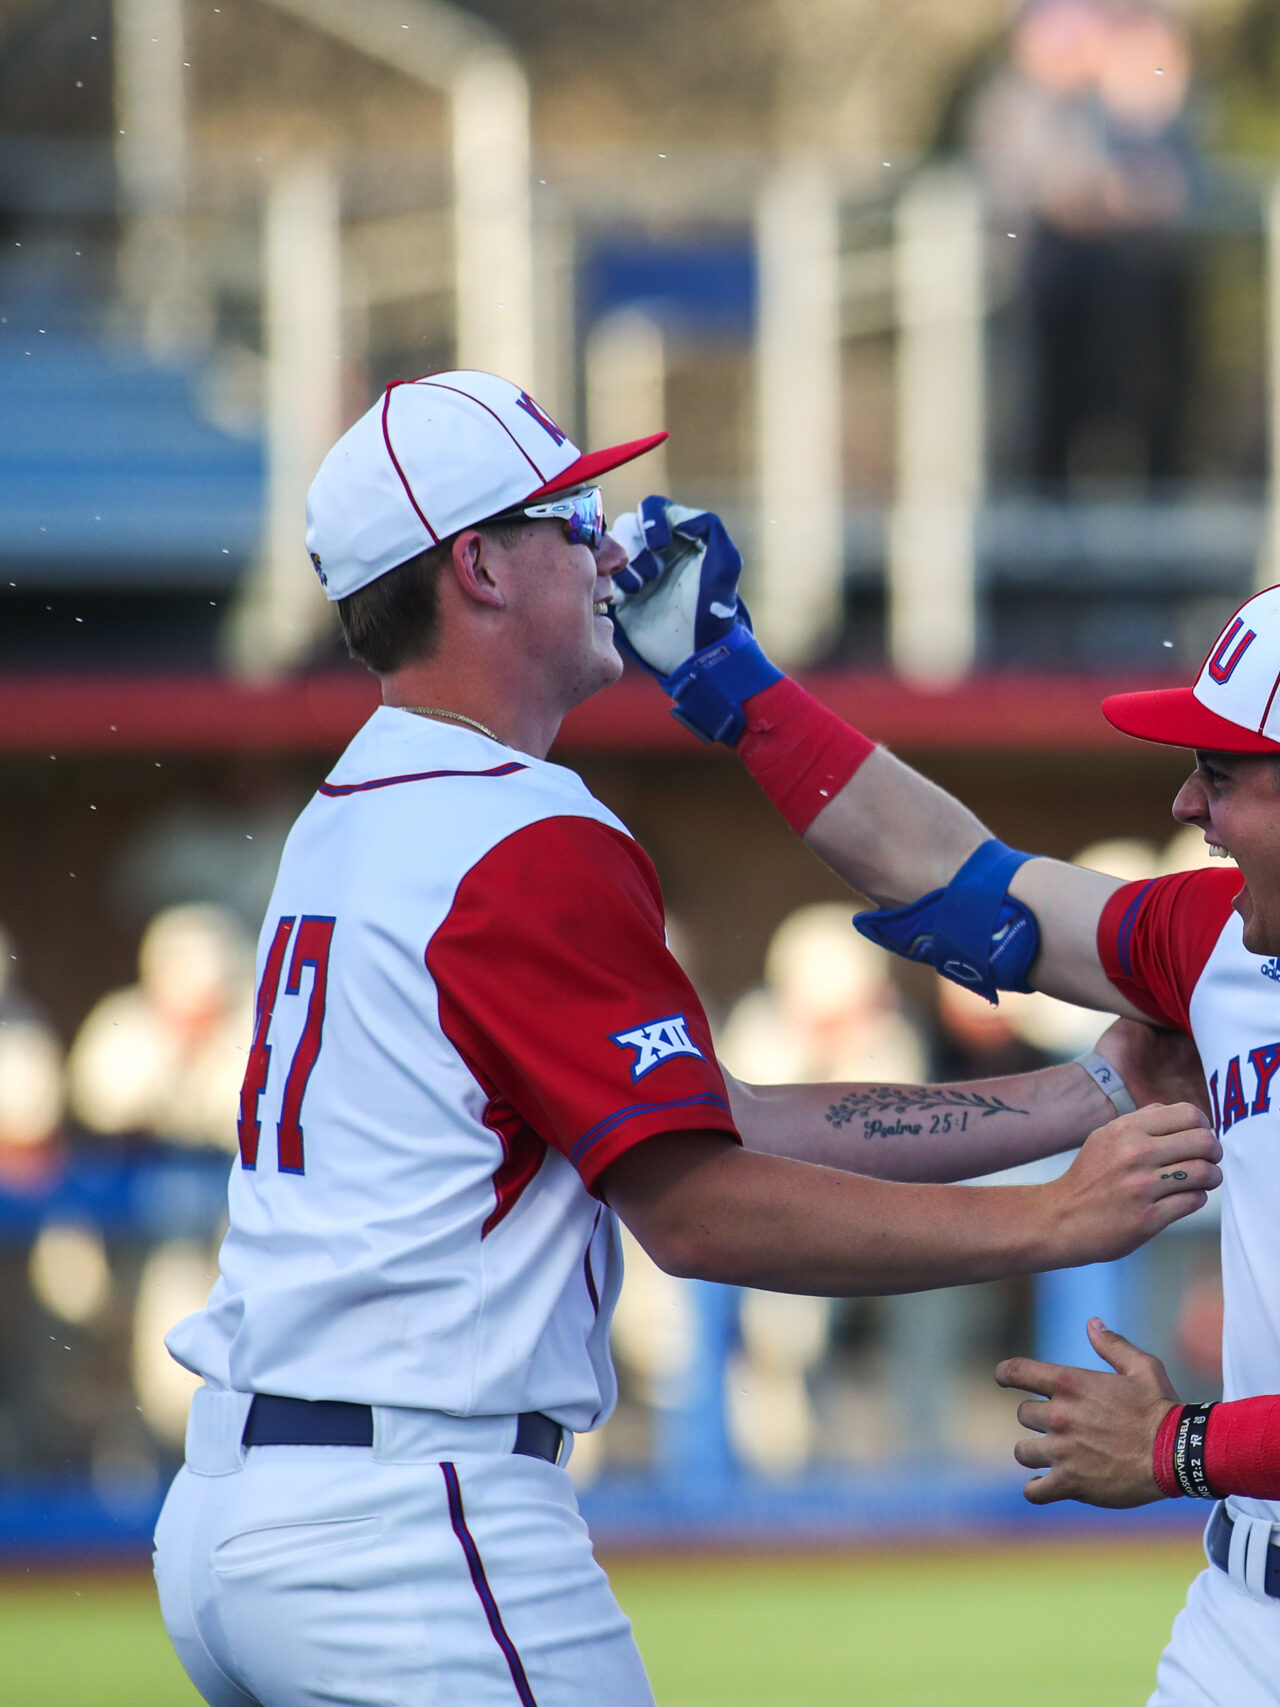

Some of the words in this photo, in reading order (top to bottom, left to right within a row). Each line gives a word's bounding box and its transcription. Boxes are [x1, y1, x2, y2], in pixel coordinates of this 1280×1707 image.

[1208, 617, 1257, 685] U
[237, 914, 337, 1176] 47
[863, 1118, 923, 1139] Psalms
[929, 1111, 968, 1134] 25:1
[1190, 1458, 1204, 1483] 12:2
